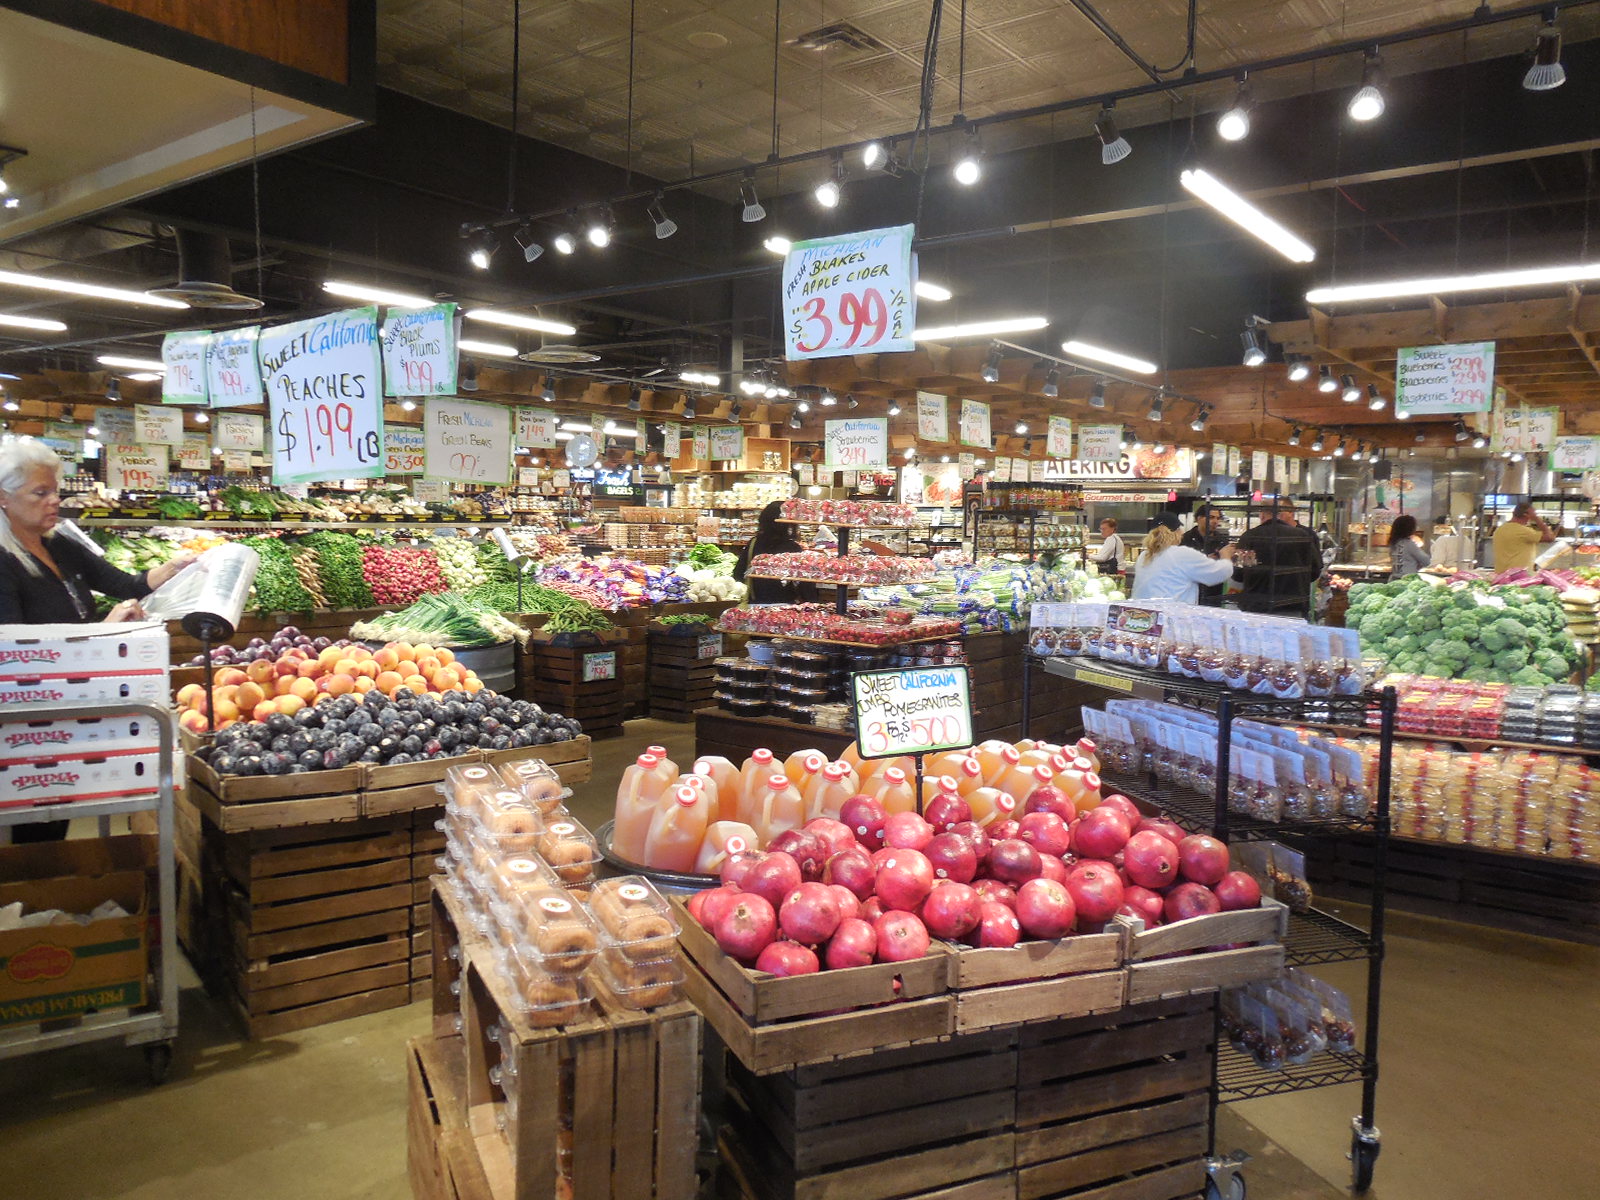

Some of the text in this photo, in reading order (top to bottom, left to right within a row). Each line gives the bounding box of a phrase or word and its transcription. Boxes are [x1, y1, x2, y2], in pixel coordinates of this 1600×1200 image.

[809, 252, 867, 277] BLAKES
[786, 264, 807, 299] FRESH
[802, 263, 891, 297] APPLE CIDER
[263, 331, 309, 380] SWEET
[309, 317, 379, 357] California
[409, 338, 441, 358] Plums
[277, 372, 366, 403] PEACHES
[357, 430, 381, 464] LB
[597, 468, 631, 487] Fresh
[1084, 493, 1125, 502] Gourmet
[1132, 493, 1146, 502] Go
[860, 673, 901, 695] SWEET
[5, 730, 73, 746] PRIMA
[866, 720, 889, 753] 3
[12, 772, 80, 788] PRIMA
